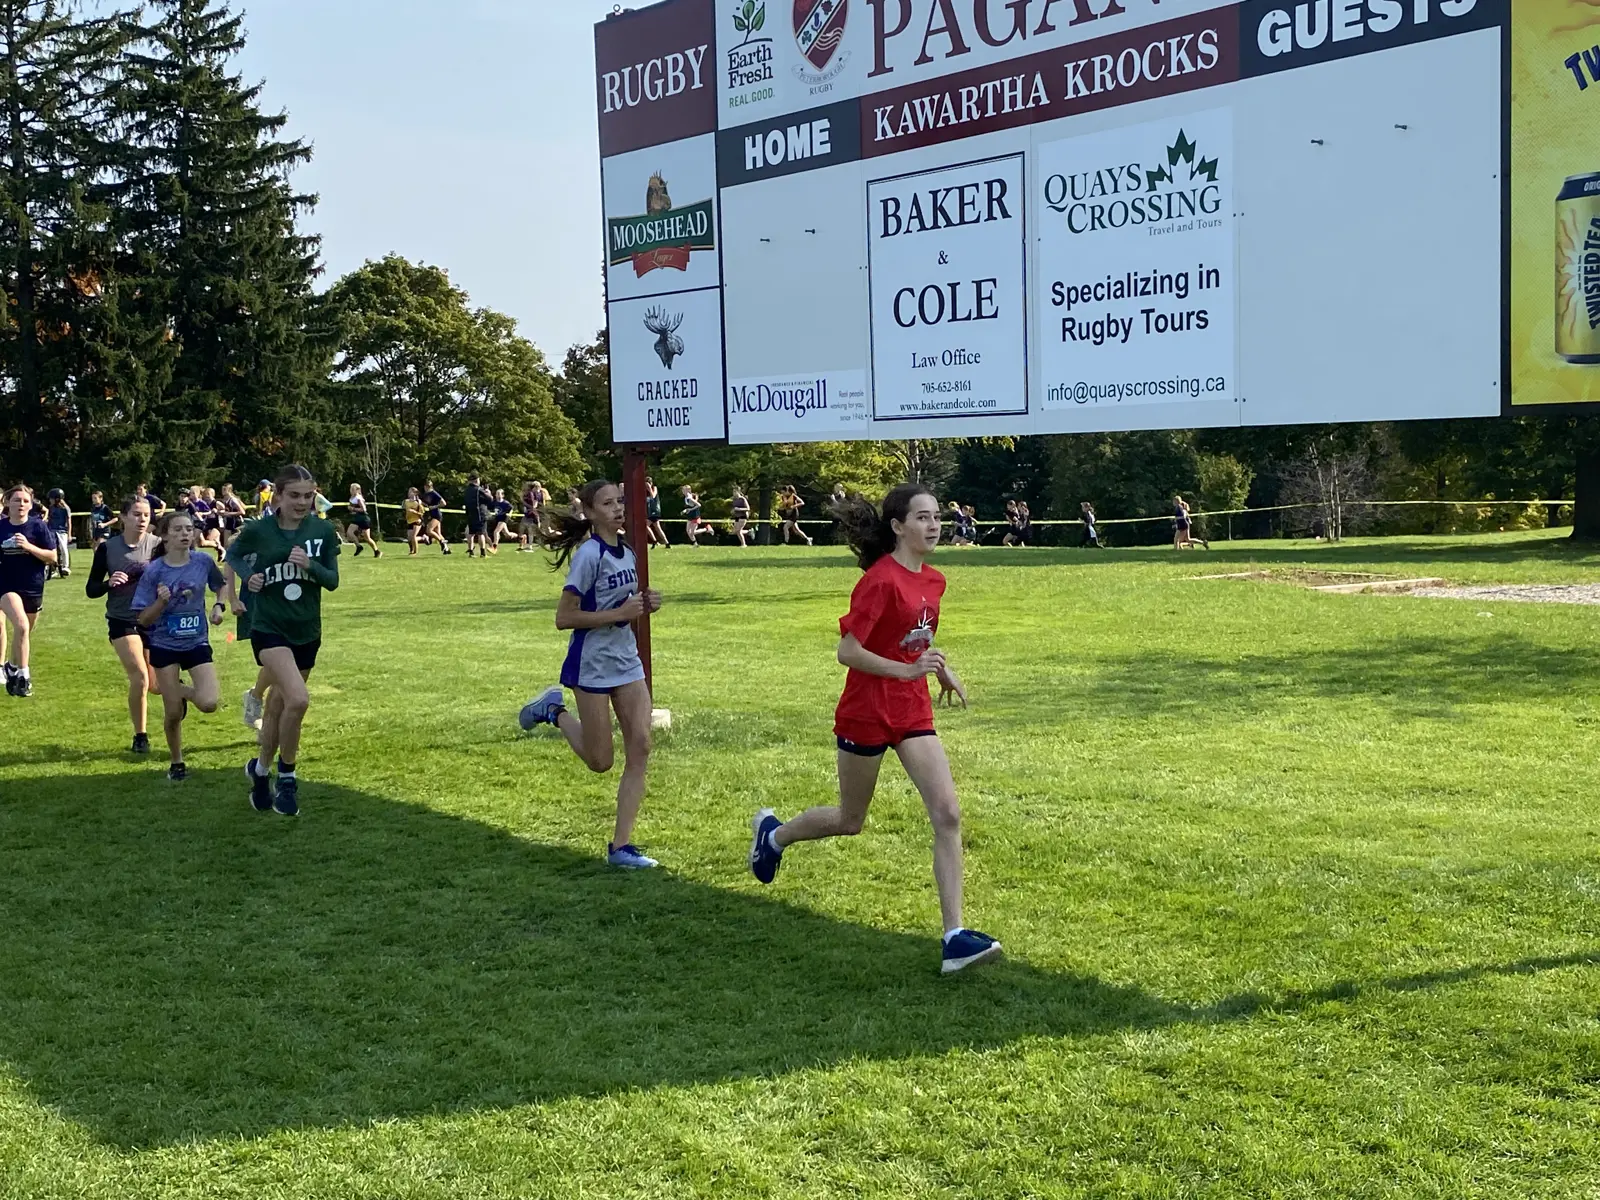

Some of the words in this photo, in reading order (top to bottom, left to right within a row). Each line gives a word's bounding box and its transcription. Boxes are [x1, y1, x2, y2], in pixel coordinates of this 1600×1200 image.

[867, 0, 1162, 78] PAG
[728, 44, 773, 71] Earth
[602, 44, 708, 114] RUGBY
[728, 63, 774, 89] Fresh
[809, 83, 834, 95] RUGBY
[874, 71, 1050, 142] KAWARTHA
[1064, 28, 1219, 101] KROCKS
[745, 118, 831, 170] HOME
[1044, 163, 1141, 213] QUAYS
[880, 178, 1012, 238] BAKER
[1067, 185, 1222, 234] CROSSING
[613, 210, 708, 251] MOOSEHEAD
[1148, 223, 1174, 236] Travel
[1177, 221, 1193, 232] and
[1196, 219, 1222, 230] Tours
[938, 250, 949, 265] &
[1051, 268, 1189, 311] Specializing
[1198, 263, 1220, 289] in
[893, 278, 999, 328] COLE
[1062, 313, 1133, 346] Rugby
[1141, 308, 1209, 334] Tours
[911, 352, 938, 369] Law
[941, 348, 981, 367] Office
[638, 378, 698, 401] CRACKED
[731, 379, 827, 418] McDougall
[921, 380, 972, 394] 705-652-8161
[1047, 375, 1225, 404] info@quayscrossing.ca
[648, 406, 690, 428] CANOE
[900, 398, 996, 412] www.bakerandcole.com
[305, 539, 323, 557] 17
[265, 562, 316, 586] LION
[180, 615, 199, 629] 820
